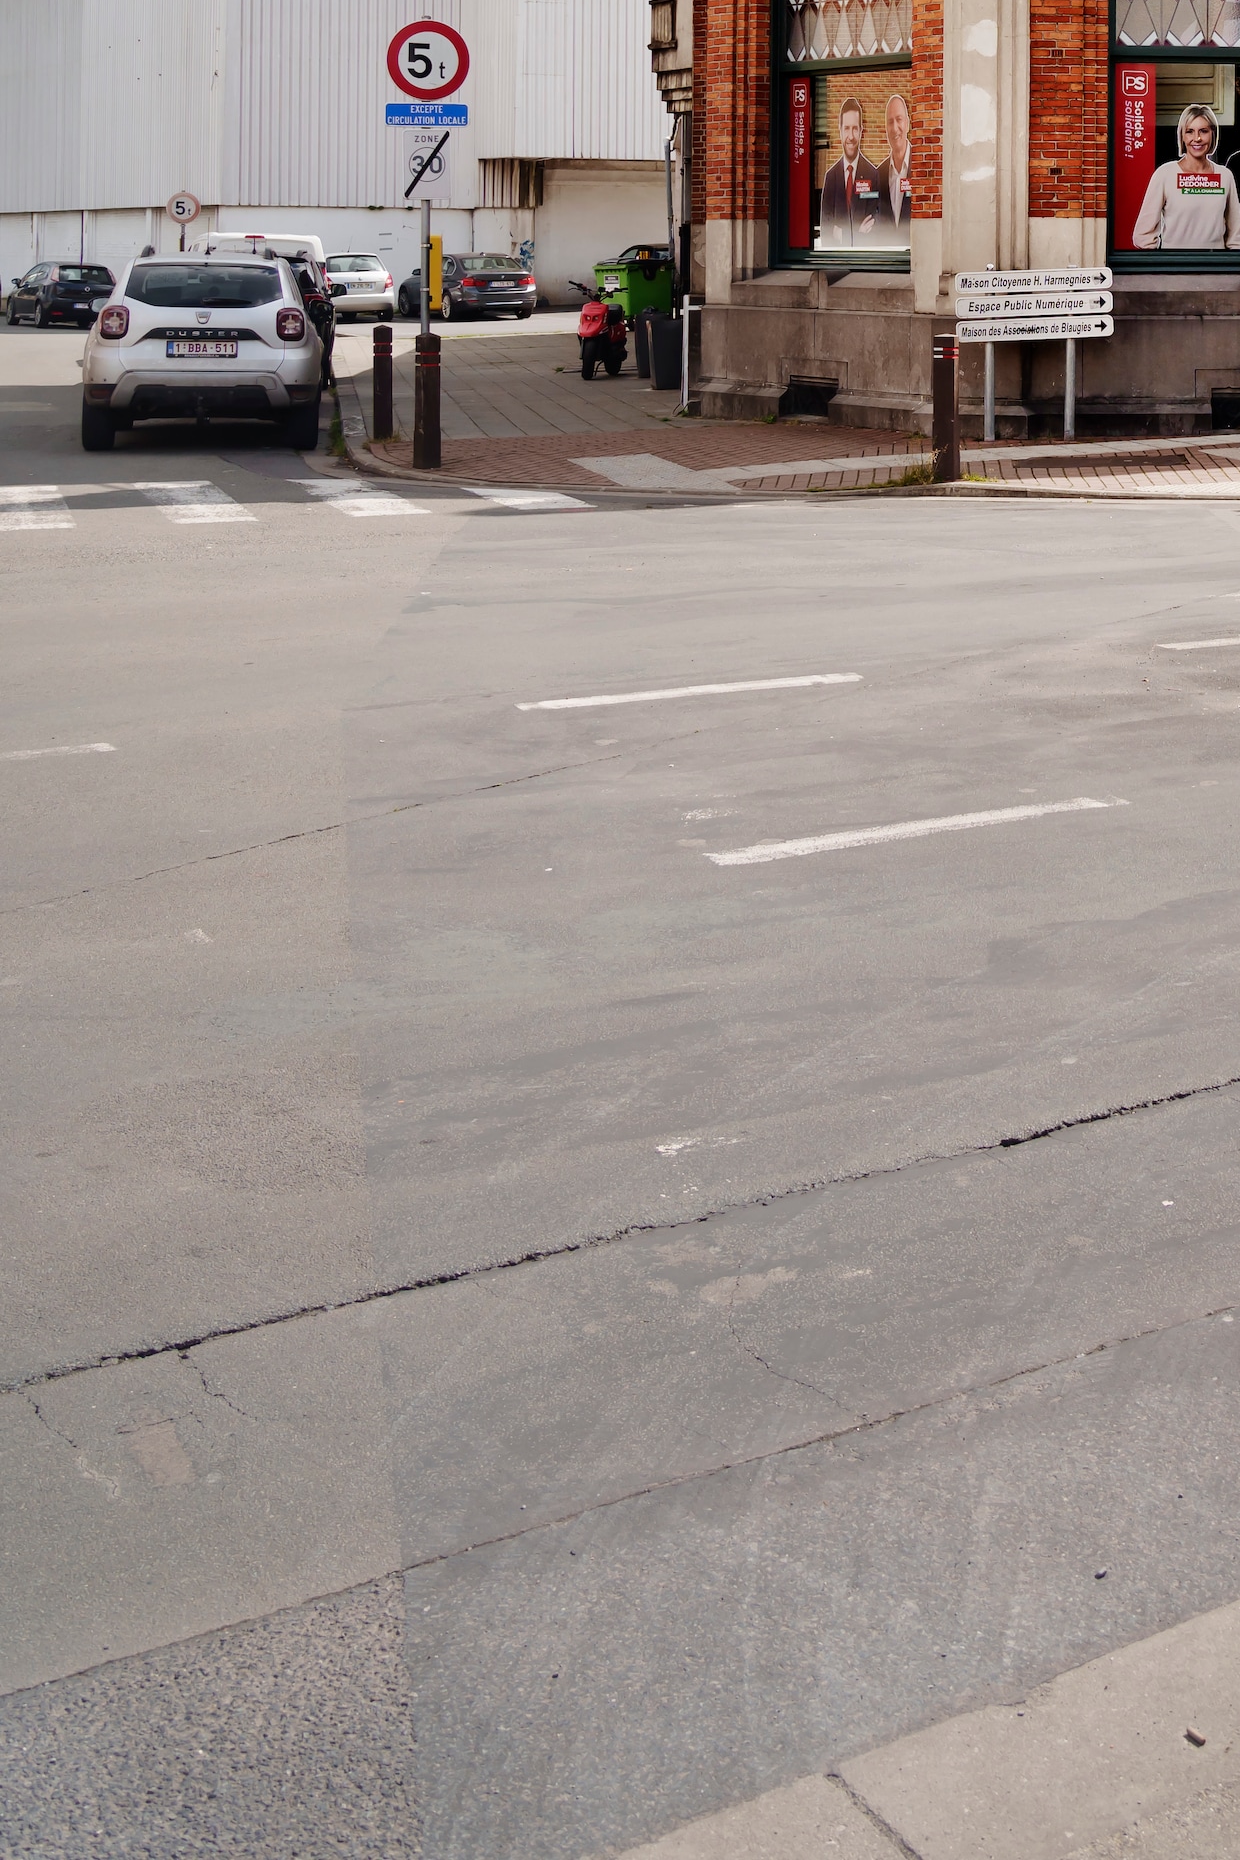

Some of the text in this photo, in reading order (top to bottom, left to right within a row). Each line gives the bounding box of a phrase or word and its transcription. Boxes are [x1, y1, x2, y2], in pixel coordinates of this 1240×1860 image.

[407, 42, 446, 79] 5 t
[1125, 76, 1146, 90] PS
[794, 89, 806, 102] PS
[410, 105, 443, 114] EXCEPTE
[387, 116, 467, 125] CIRCULATION LOCALE
[1134, 100, 1145, 138] Solide
[414, 135, 439, 143] ZONE
[412, 155, 443, 174] 30
[1179, 174, 1208, 182] Ludivine
[175, 201, 186, 215] 5
[991, 276, 1032, 290] Citoyenne
[1033, 275, 1042, 286] H.
[1044, 274, 1091, 287] Harmegnies
[968, 298, 1084, 314] Espace Public Numérique
[961, 326, 987, 338] Maison
[989, 325, 1001, 336] des
[1050, 322, 1059, 333] de
[1061, 320, 1092, 335] Blaugies
[175, 343, 235, 353] 1-BBA-511
